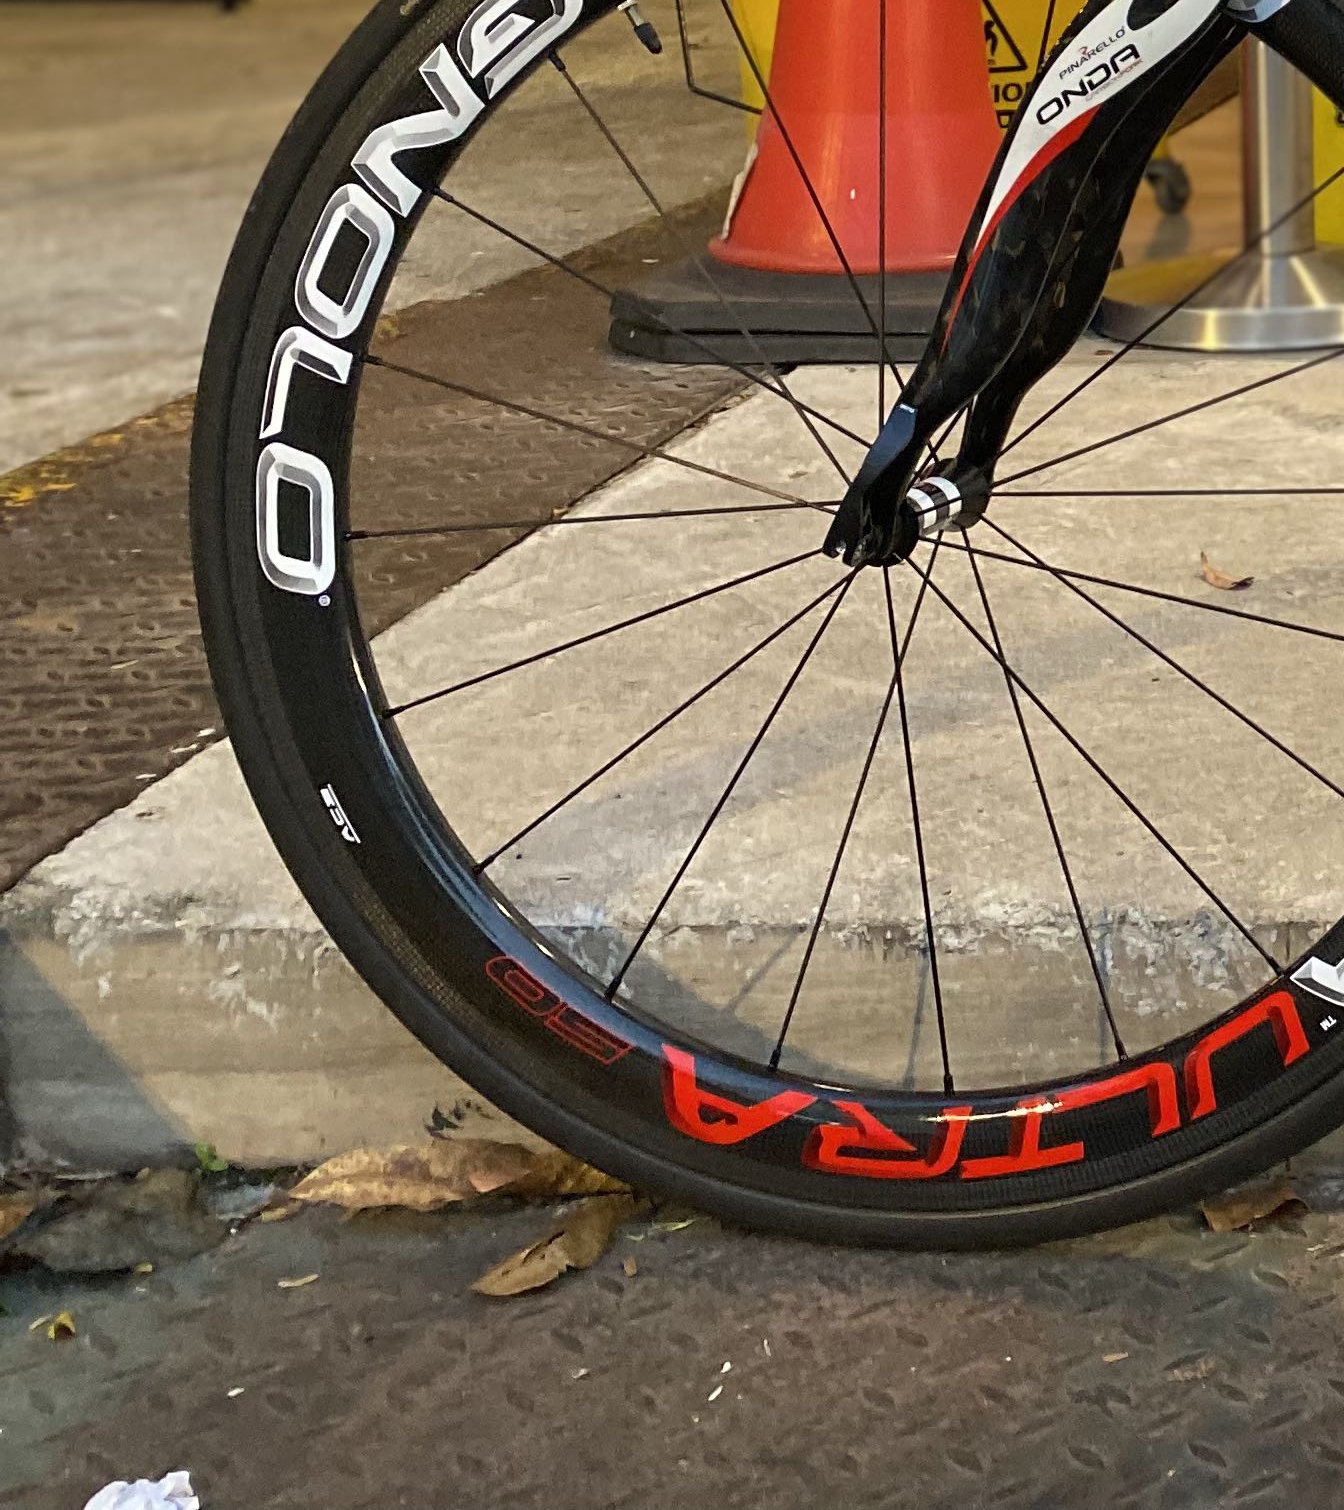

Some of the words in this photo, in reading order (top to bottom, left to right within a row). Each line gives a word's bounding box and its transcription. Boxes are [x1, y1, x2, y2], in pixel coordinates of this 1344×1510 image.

[1036, 43, 1141, 125] ONDA
[1059, 26, 1126, 80] PINARELLO
[660, 989, 1314, 1182] ULTRA
